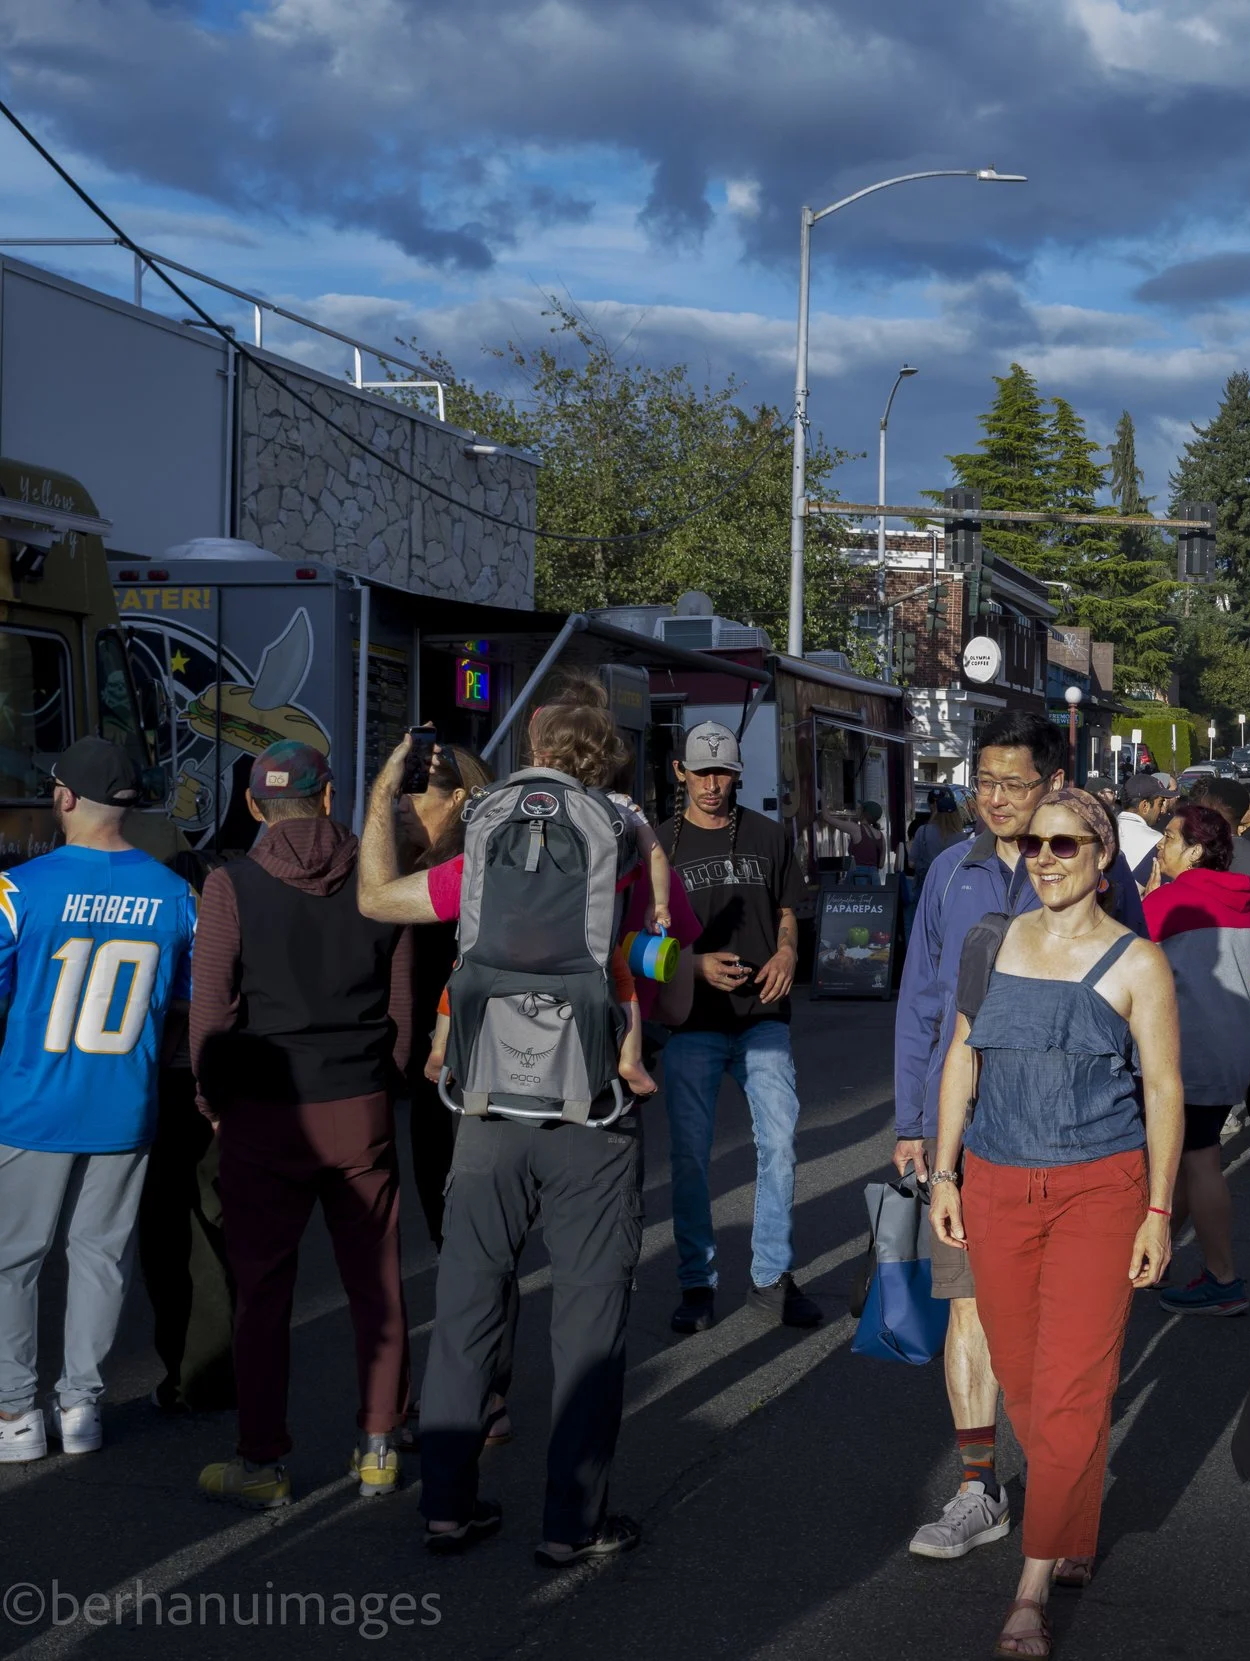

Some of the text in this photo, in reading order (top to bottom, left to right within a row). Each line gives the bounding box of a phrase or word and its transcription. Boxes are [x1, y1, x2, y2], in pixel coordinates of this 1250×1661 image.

[20, 475, 75, 511] Yellow
[61, 893, 163, 926] HERBERT
[825, 904, 884, 914] PAPAREPAS
[43, 937, 161, 1055] 10
[510, 1073, 541, 1084] POCO
